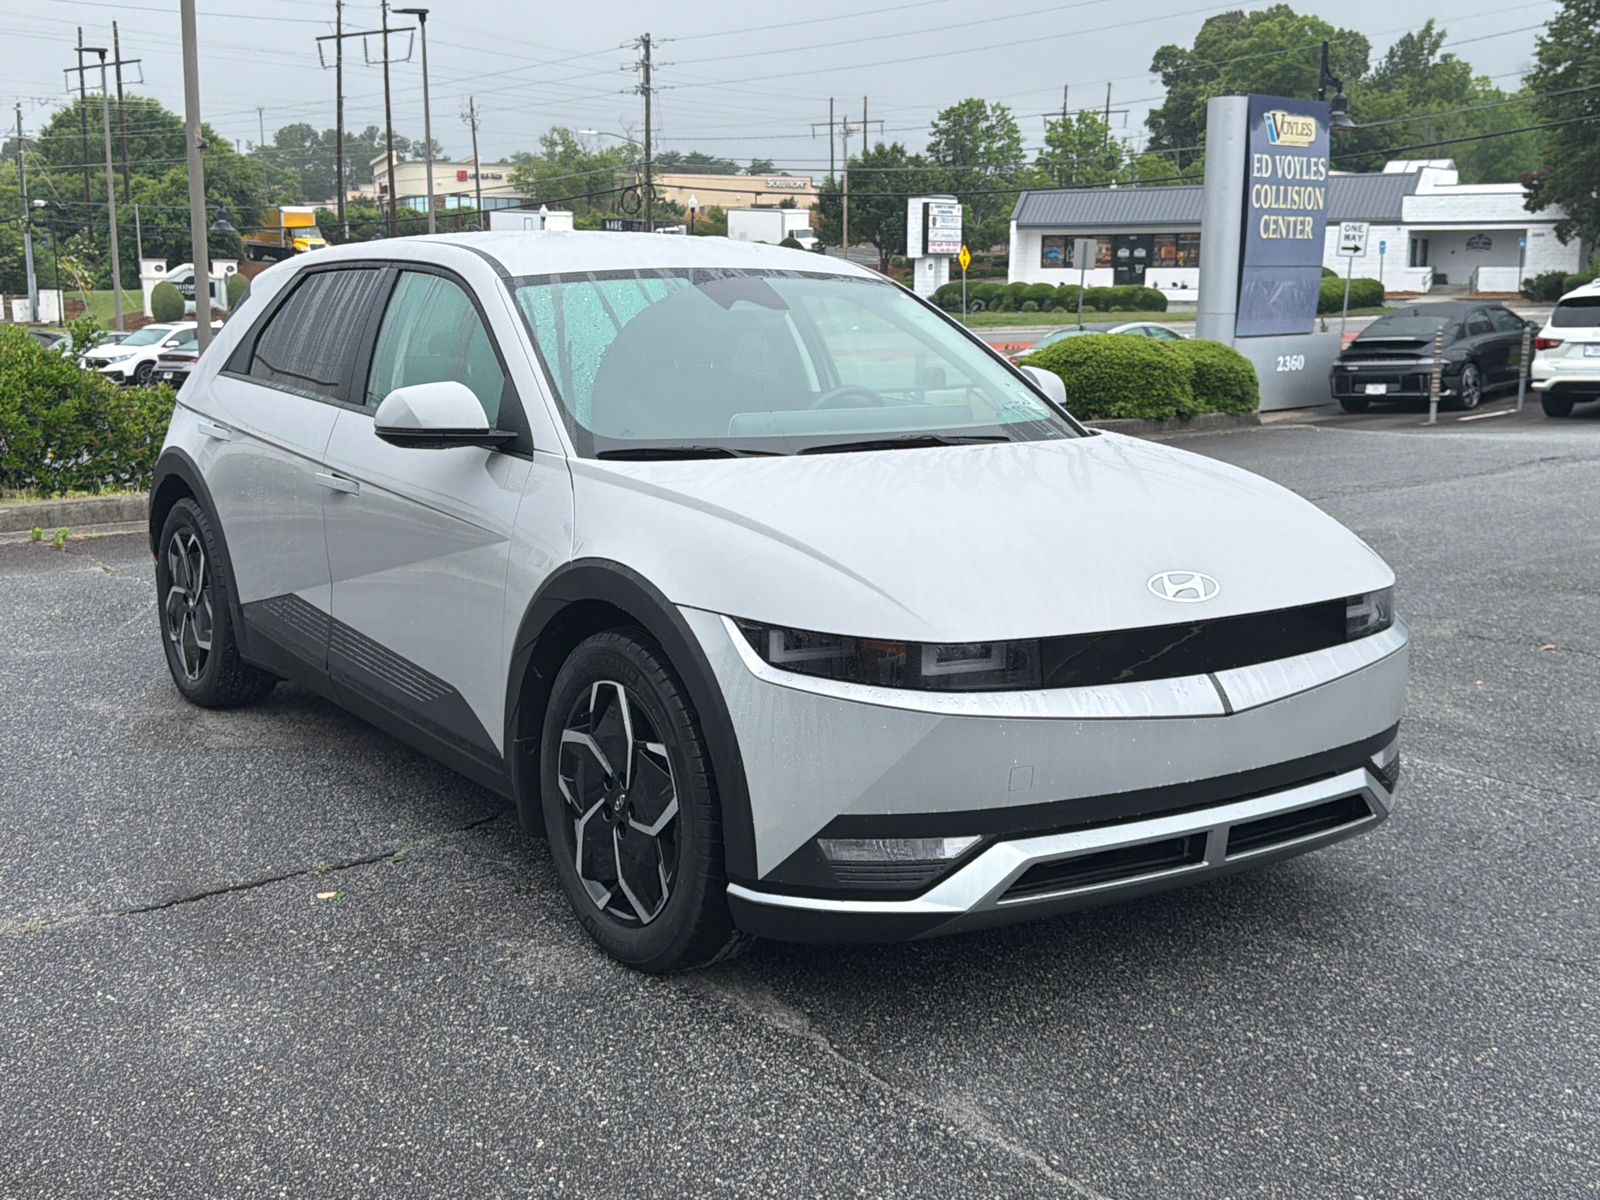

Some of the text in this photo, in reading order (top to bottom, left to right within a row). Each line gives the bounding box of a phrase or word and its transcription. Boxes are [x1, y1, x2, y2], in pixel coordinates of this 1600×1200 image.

[1272, 113, 1312, 140] VOYLES
[1252, 154, 1327, 181] ED VOYLES
[1252, 184, 1326, 211] COLLISION
[1259, 214, 1314, 240] CENTER
[1343, 233, 1365, 242] WAY
[1344, 224, 1364, 233] ONE
[1276, 354, 1305, 372] 2360
